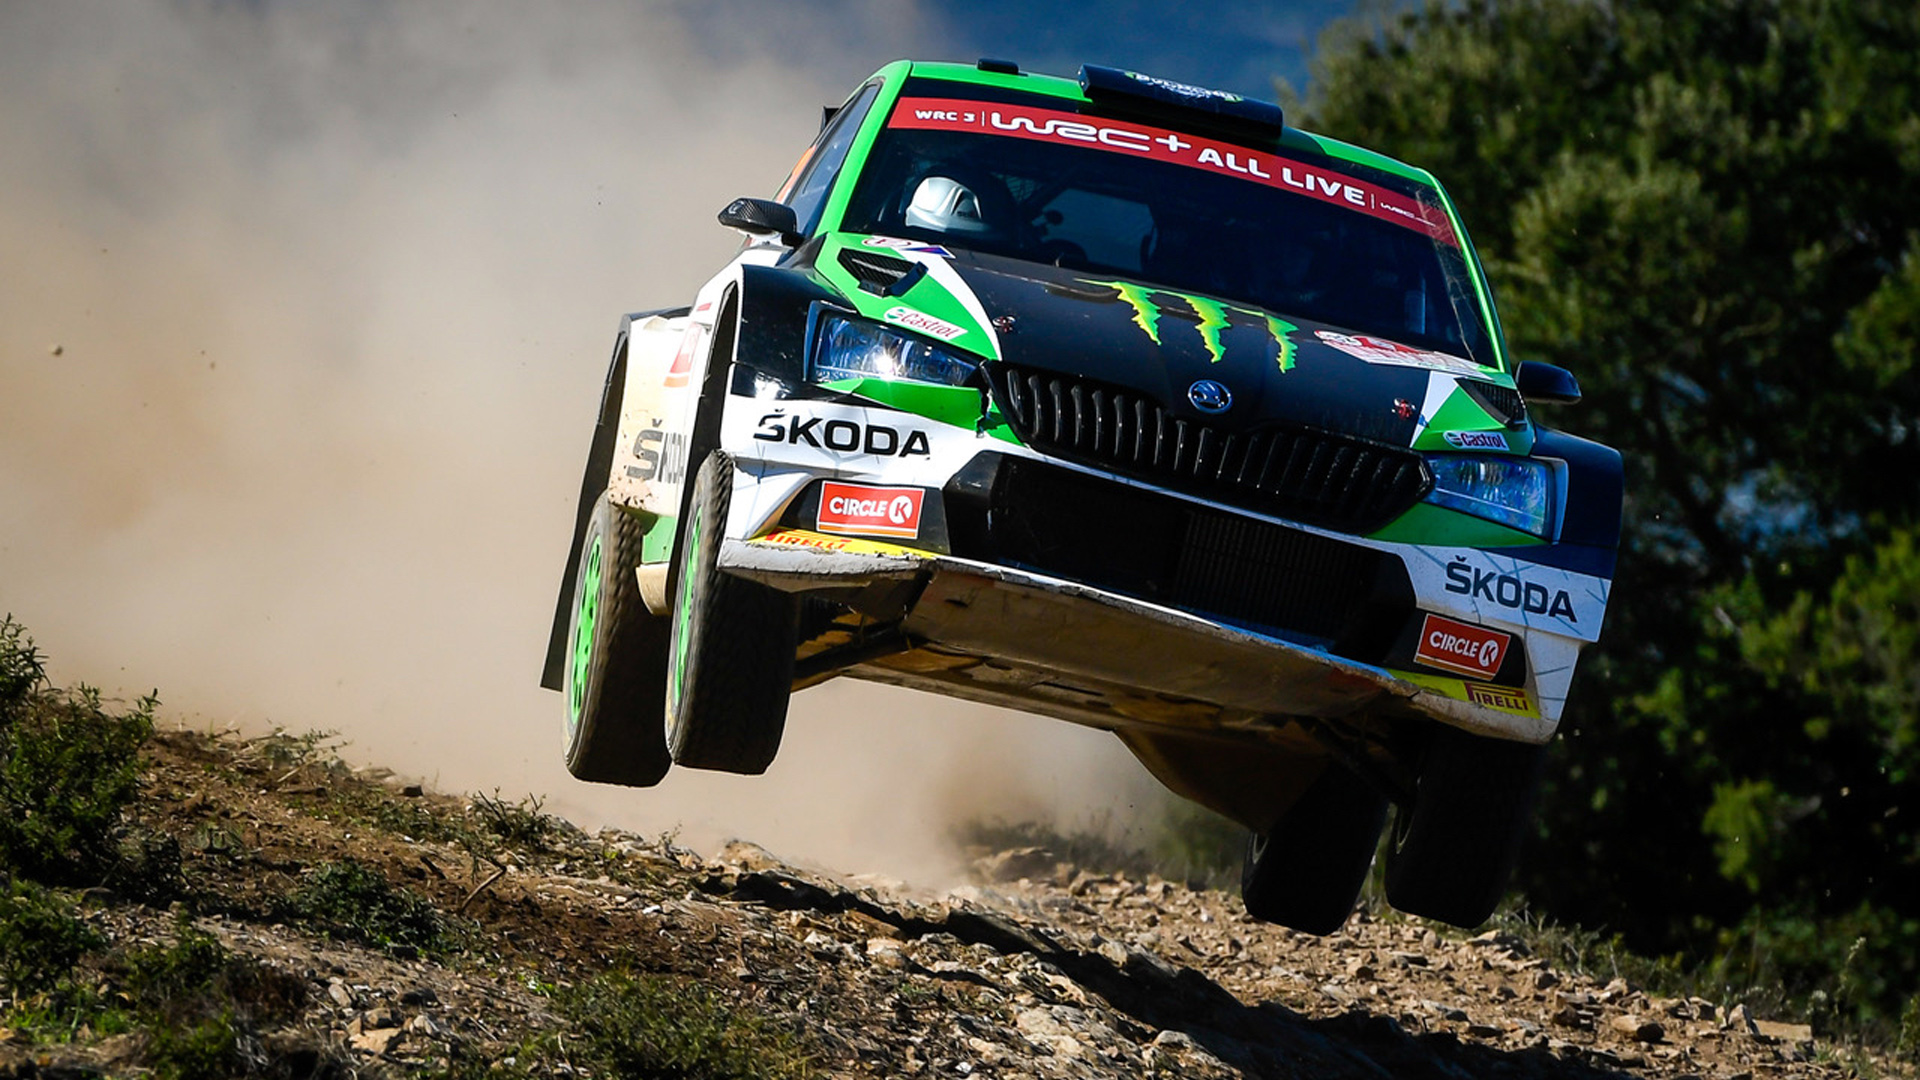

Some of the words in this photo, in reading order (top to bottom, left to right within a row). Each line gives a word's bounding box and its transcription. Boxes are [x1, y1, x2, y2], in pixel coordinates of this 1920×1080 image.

[915, 110, 958, 121] WRC
[964, 112, 975, 122] 3
[1197, 148, 1270, 179] ALL
[1282, 167, 1366, 206] LIVE
[901, 312, 959, 337] Castrol
[753, 408, 931, 461] ŠKODA
[1461, 432, 1506, 449] Castrol
[829, 495, 888, 517] CIRCLE
[889, 495, 913, 525] K
[765, 527, 852, 551] PIRELLI
[1445, 555, 1577, 623] ŠKODA
[1429, 631, 1480, 657] CIRCLE
[1478, 639, 1499, 667] K
[1464, 680, 1528, 711] PIRELLI
